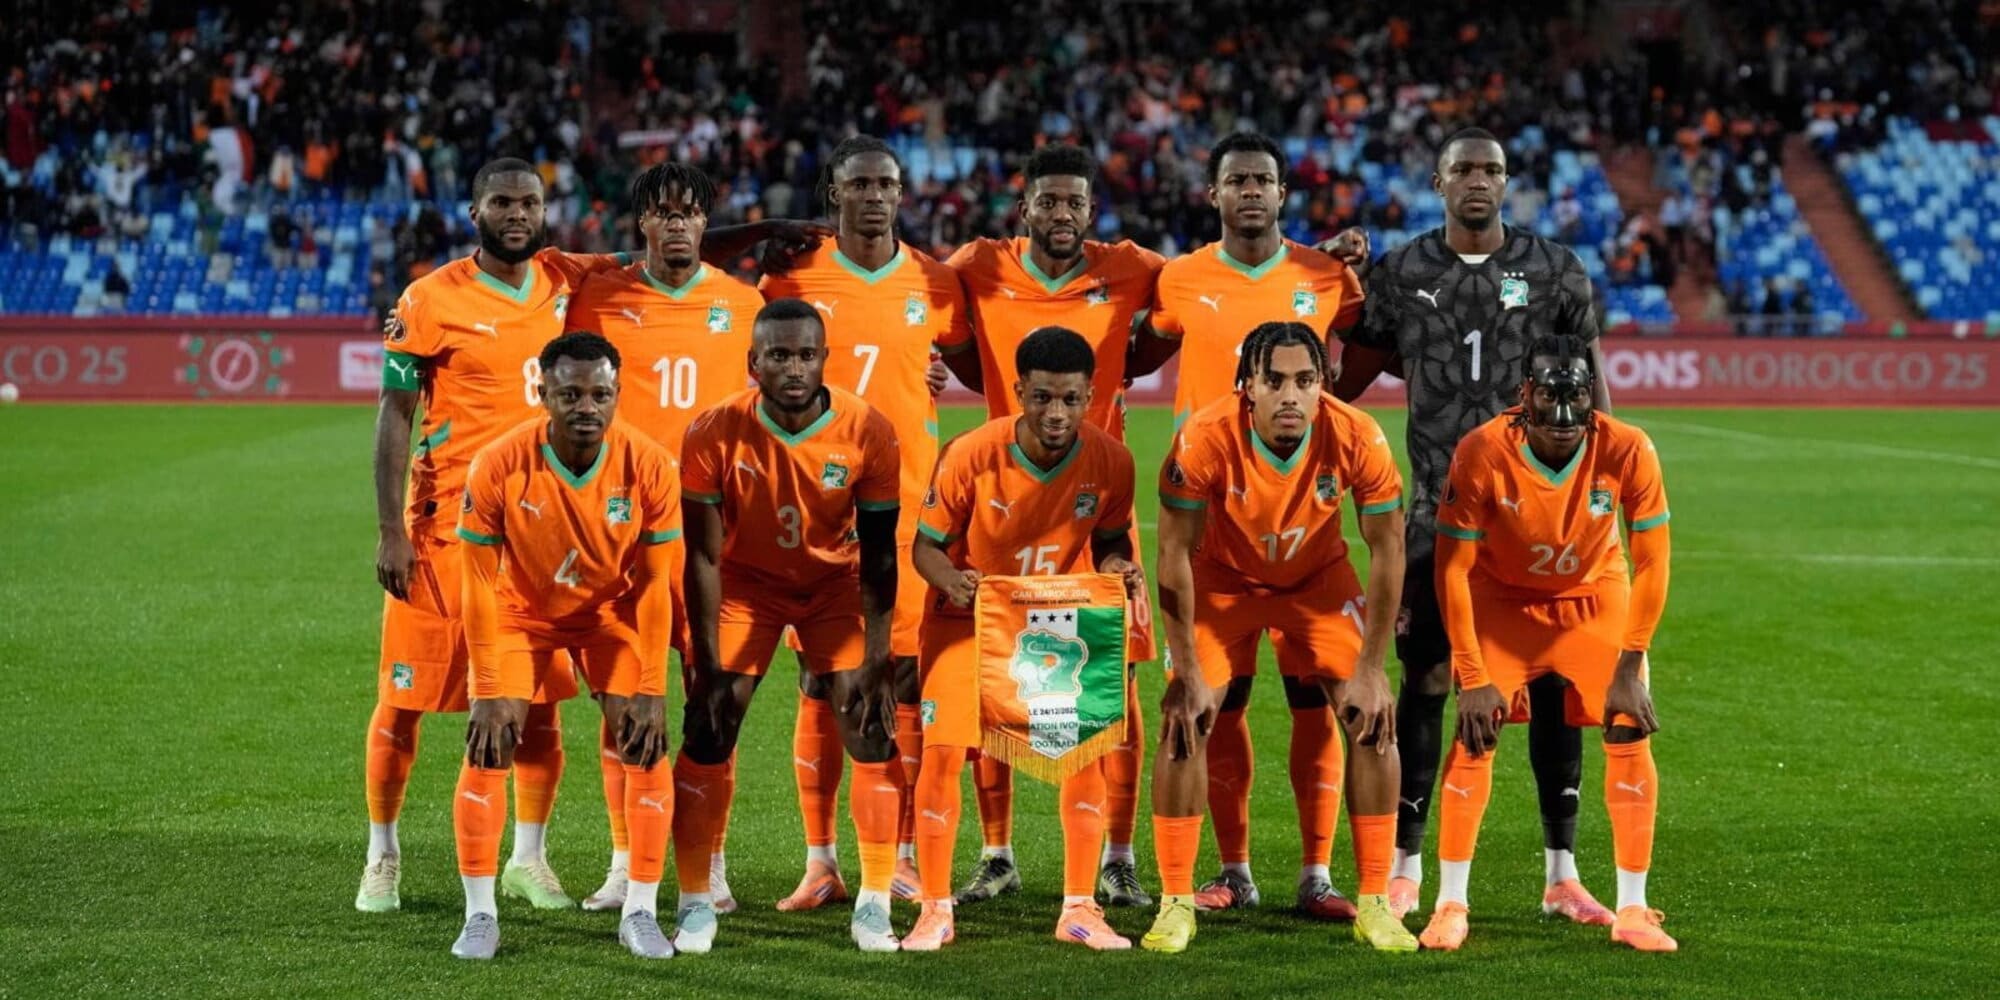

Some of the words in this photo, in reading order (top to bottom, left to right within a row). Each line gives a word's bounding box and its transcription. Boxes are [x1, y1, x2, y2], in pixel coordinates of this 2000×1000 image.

[79, 345, 128, 385] 25
[854, 344, 880, 396] 7
[1463, 329, 1482, 381] 1
[1603, 349, 1701, 390] ONS
[1705, 350, 1934, 391] MOROCCO
[1940, 350, 1989, 391] 25
[522, 356, 543, 407] 8
[652, 356, 698, 409] 10
[776, 505, 800, 549] 3
[1259, 526, 1306, 562] 17
[554, 548, 581, 589] 4
[1015, 544, 1060, 576] 15
[1527, 543, 1580, 576] 26
[1011, 590, 1032, 600] CAN
[1028, 708, 1038, 716] LE
